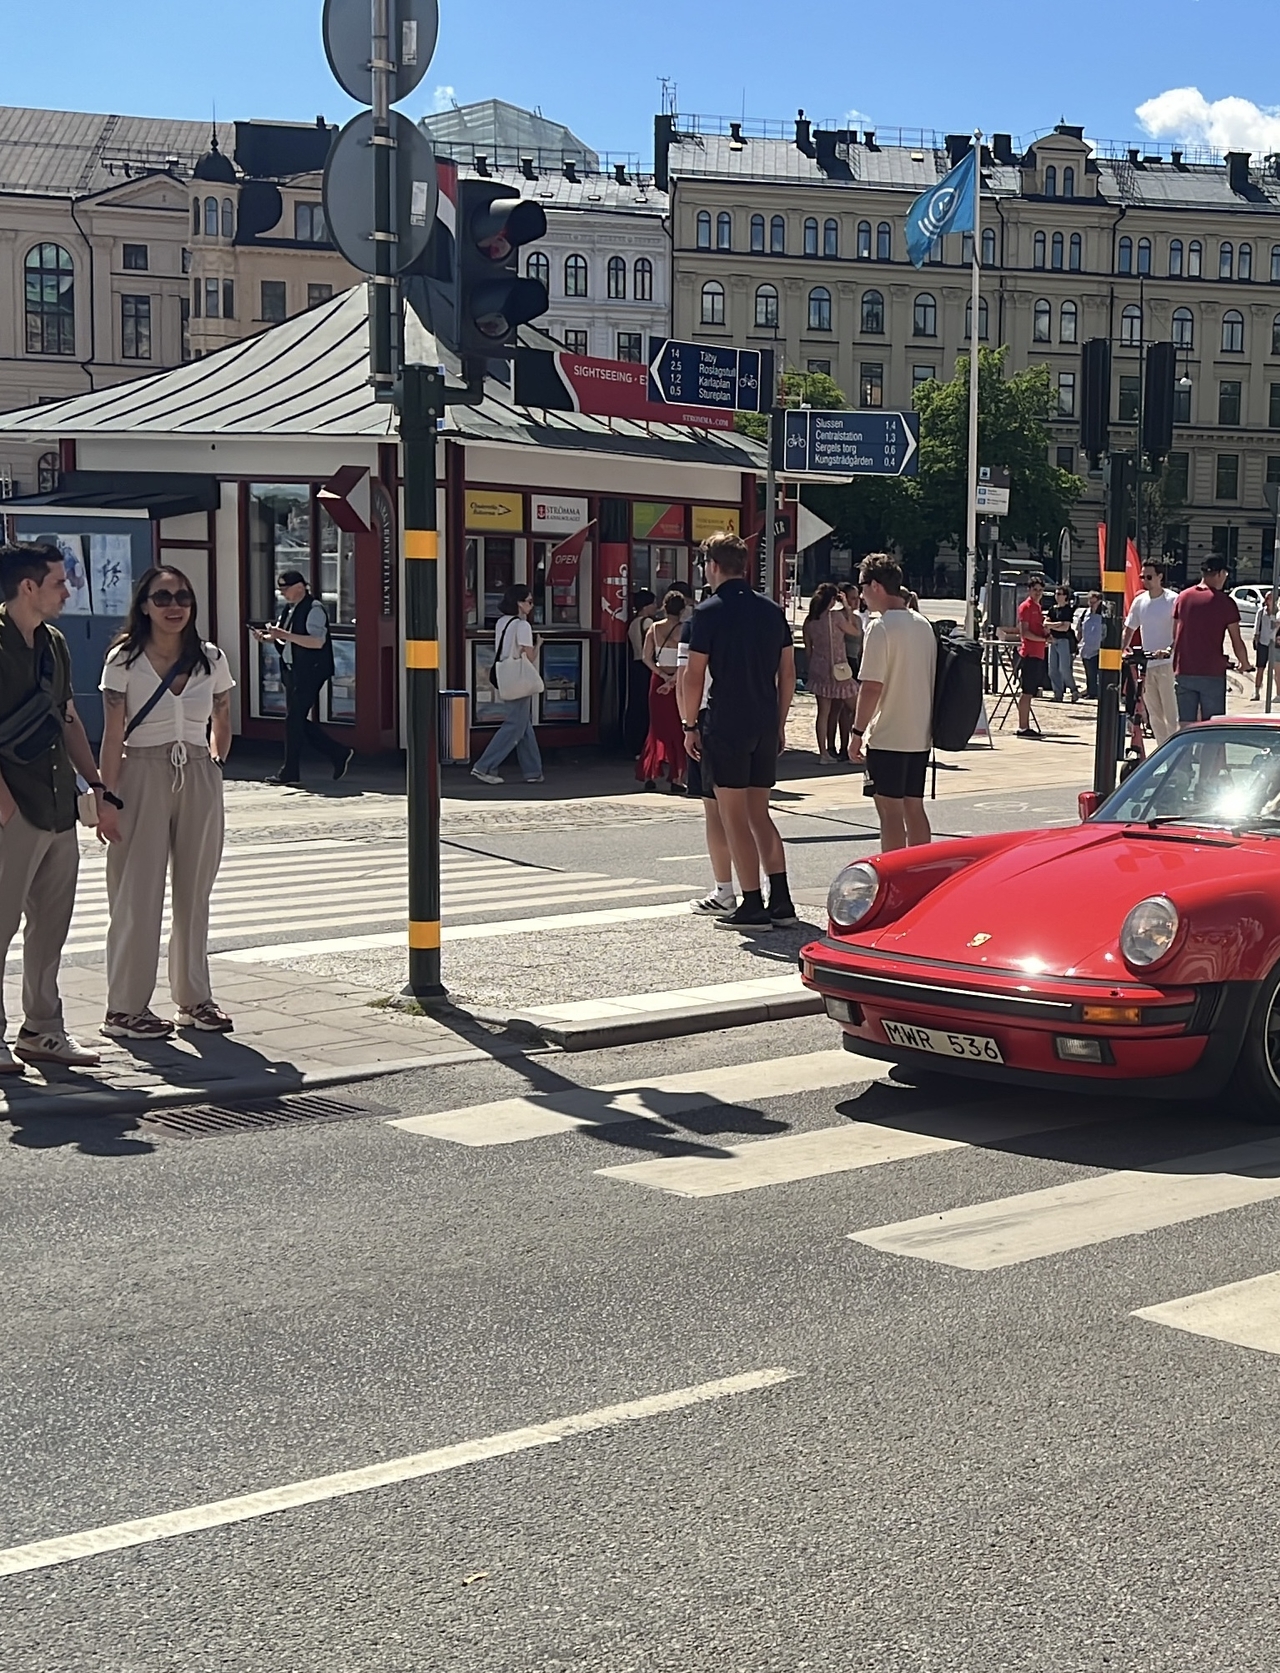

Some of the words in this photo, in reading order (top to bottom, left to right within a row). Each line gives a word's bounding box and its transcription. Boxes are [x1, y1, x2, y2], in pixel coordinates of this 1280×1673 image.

[671, 348, 680, 358] 14
[700, 351, 718, 364] Täby
[574, 364, 632, 383] SIGHTSEEING
[698, 364, 736, 378] Roslagstull
[698, 376, 730, 390] Karlaplan
[670, 386, 682, 396] 0,5
[698, 388, 731, 402] Stureplan
[815, 418, 844, 428] Slussen
[886, 421, 896, 431] 1,4
[815, 430, 862, 442] Centralstation
[886, 433, 896, 443] 1,3
[815, 442, 841, 454] Sergels
[842, 443, 857, 454] torg
[884, 445, 896, 455] 0,6
[814, 454, 874, 466] Kungsträdgården
[884, 457, 895, 468] 0,4
[554, 555, 578, 564] OPEN
[885, 1022, 934, 1050] MWR
[947, 1035, 998, 1060] 536
